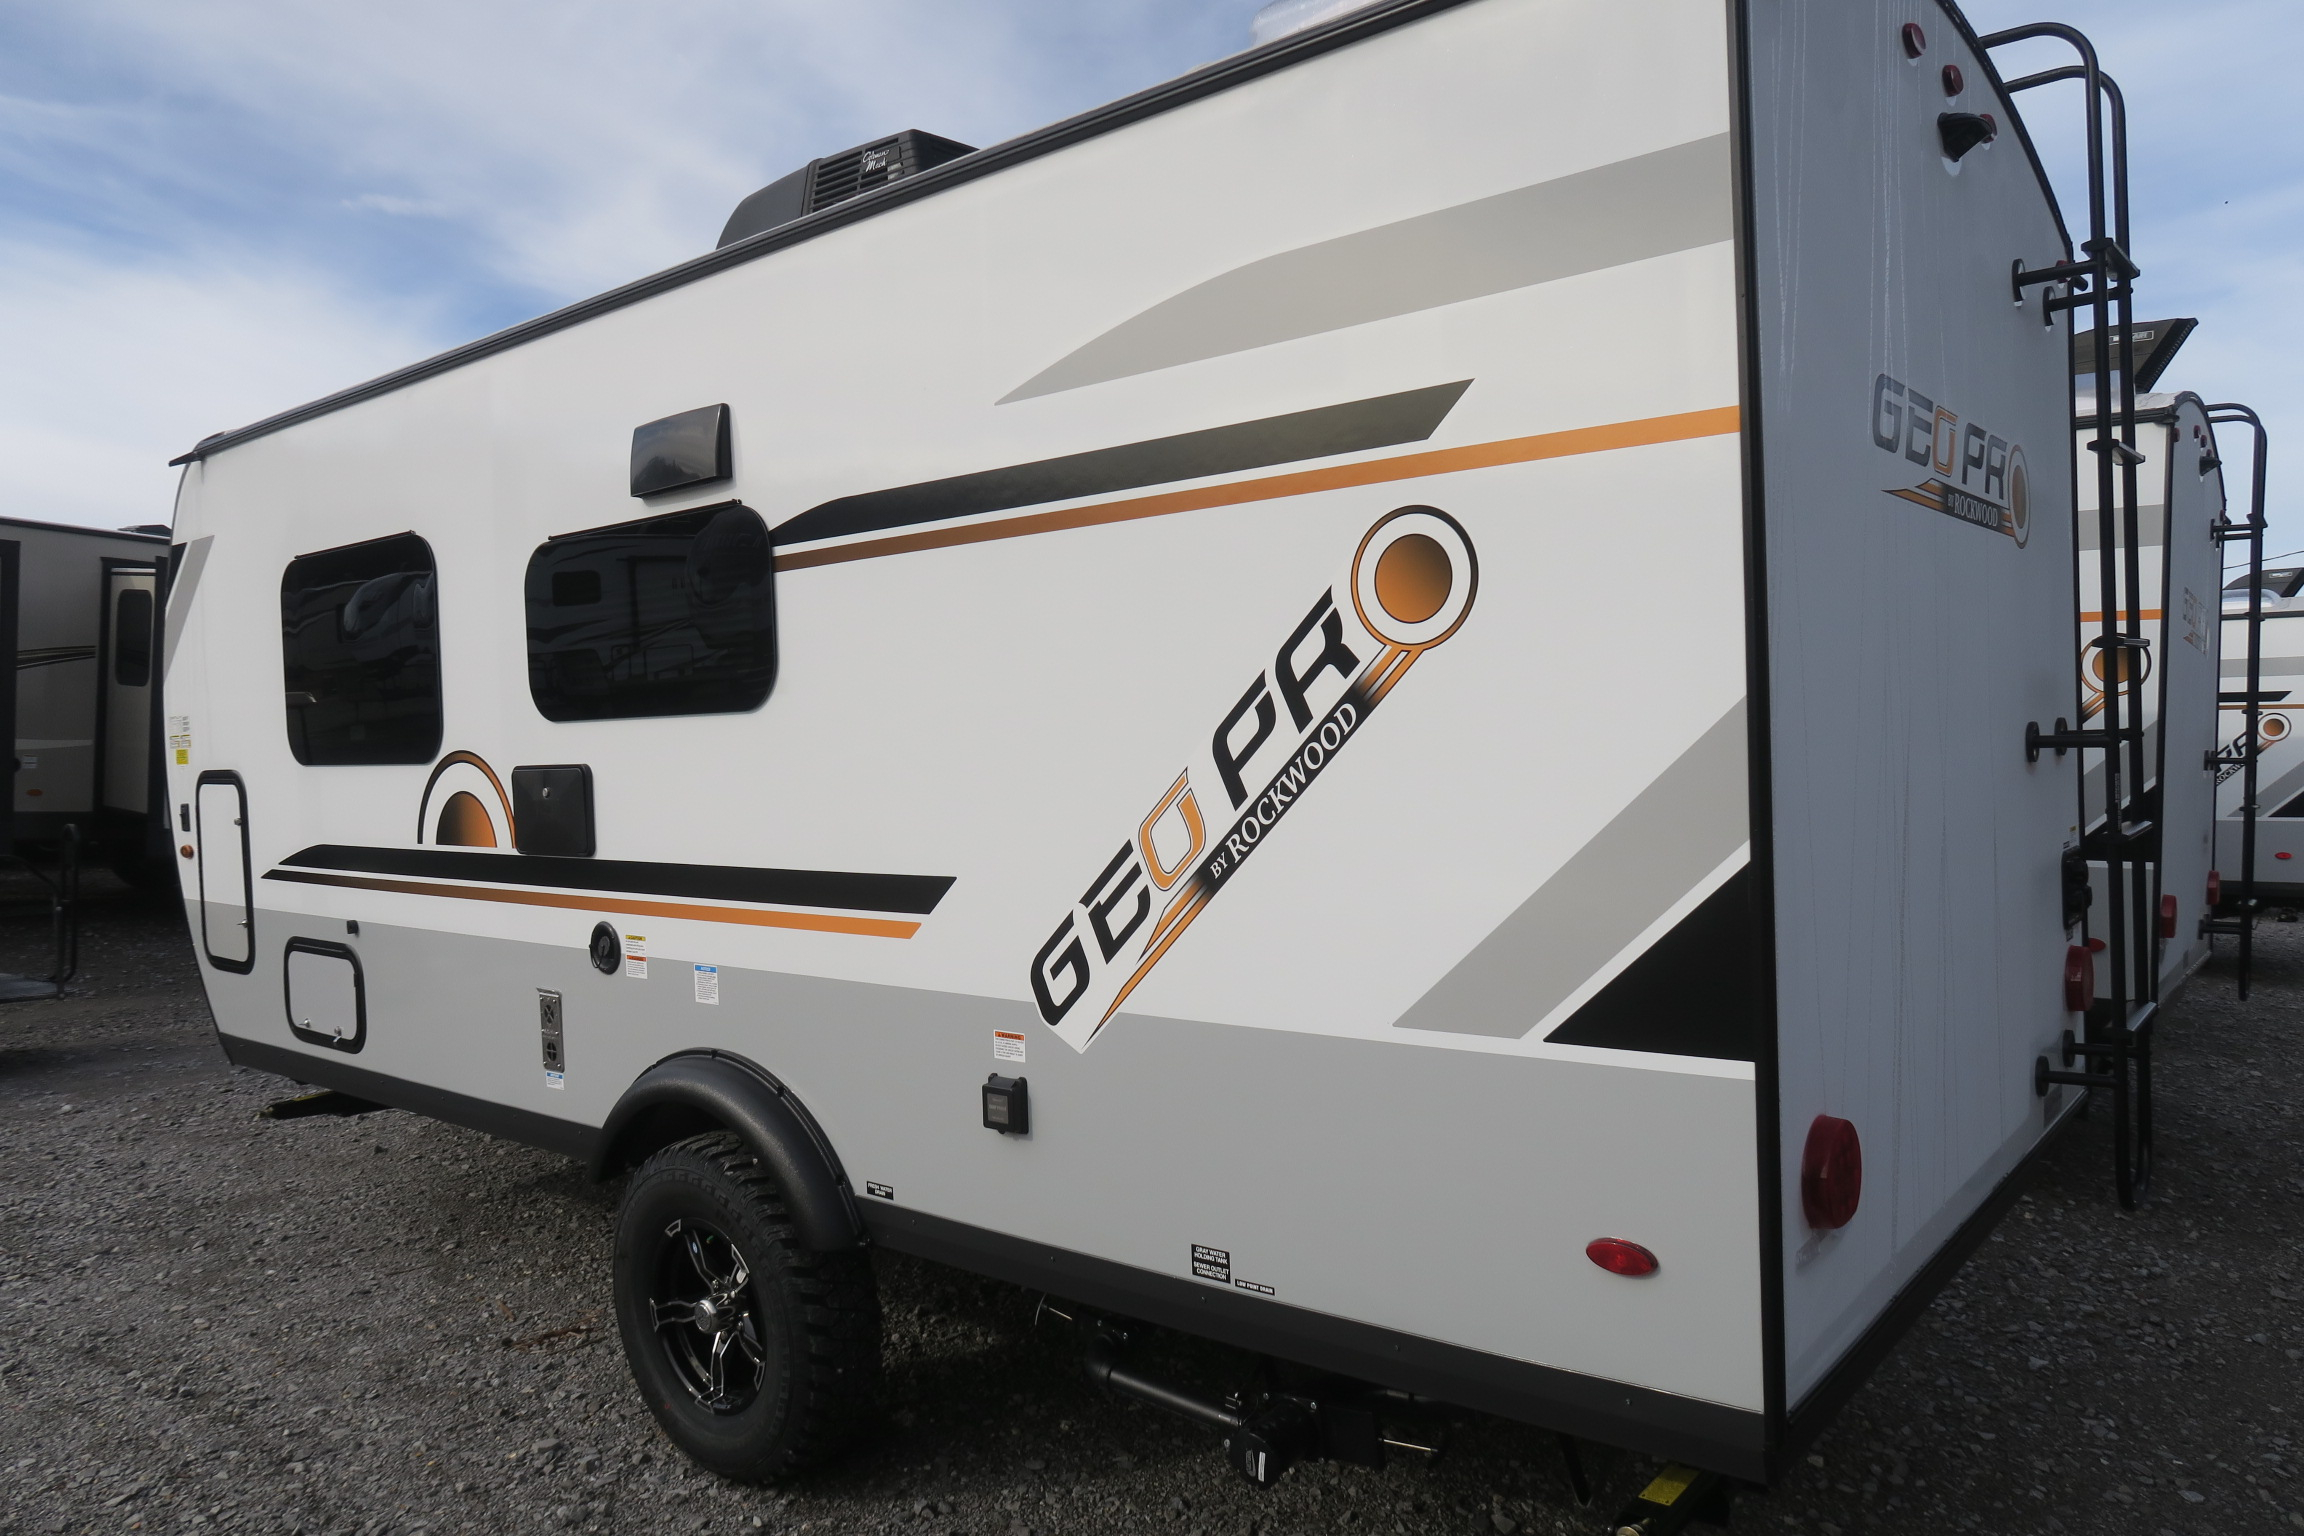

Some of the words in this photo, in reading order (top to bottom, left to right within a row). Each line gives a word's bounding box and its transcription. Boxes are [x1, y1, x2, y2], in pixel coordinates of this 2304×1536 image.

[1872, 373, 1959, 478] GEO
[1954, 493, 1998, 527] ROCKWOOD
[1208, 852, 1230, 880] BY
[1226, 701, 1359, 863] ROCKWOOD
[1030, 766, 1207, 1026] GEO
[1194, 1252, 1215, 1262] HOLDING
[1215, 1256, 1228, 1265] TANK
[1195, 1246, 1209, 1255] GRAY
[1209, 1249, 1226, 1259] WATER
[1193, 1261, 1211, 1271] SEWER
[1210, 1265, 1229, 1275] OUTLET
[1196, 1268, 1227, 1281] CONNECTION
[1246, 1283, 1260, 1291] POINT
[1259, 1286, 1274, 1294] DRAIN
